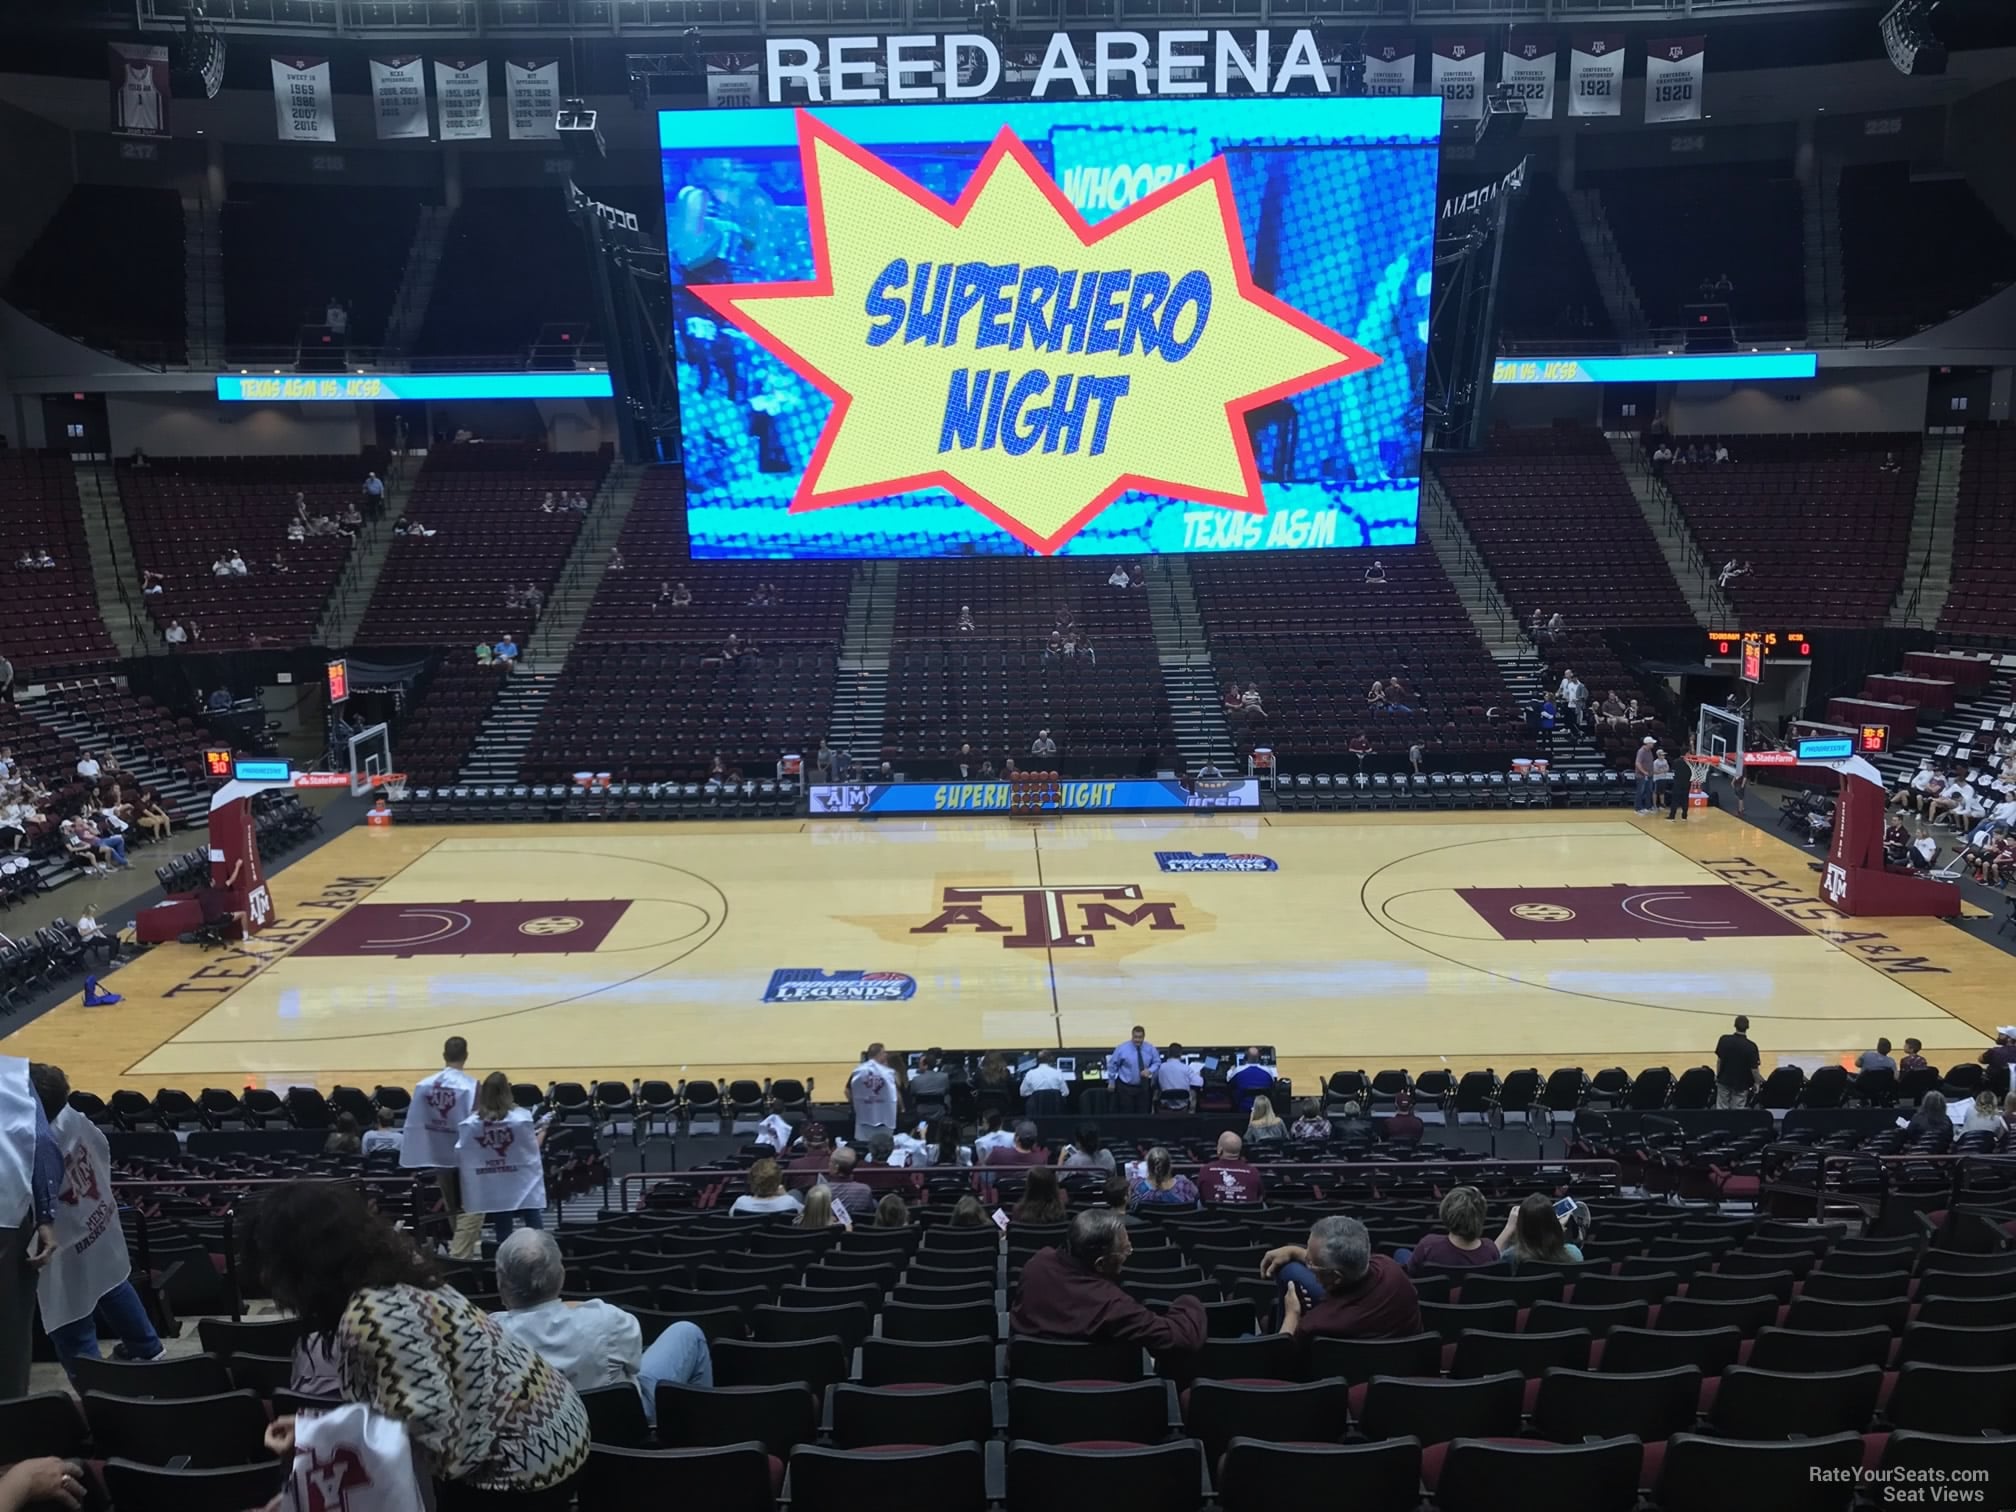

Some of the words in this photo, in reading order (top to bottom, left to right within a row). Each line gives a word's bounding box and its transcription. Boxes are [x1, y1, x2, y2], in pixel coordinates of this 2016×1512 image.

[765, 34, 1001, 102] REED
[1030, 29, 1332, 97] ARENA
[291, 84, 315, 95] 1969
[1440, 84, 1475, 100] 1923
[1580, 80, 1611, 96] 1921
[1655, 85, 1692, 102] 1920
[292, 96, 316, 107] 1980
[292, 108, 317, 119] 2007
[294, 120, 318, 131] 2016
[865, 258, 1213, 363] SUPERHERO
[1544, 361, 1578, 380] UCSB
[240, 379, 280, 398] TEXAS
[346, 378, 382, 398] UCSB
[938, 367, 1131, 457] NIGHT
[1182, 508, 1264, 550] TEXAS
[1266, 506, 1339, 548] A&M
[1720, 642, 1728, 653] 0
[1801, 643, 1810, 655] 0
[1865, 738, 1881, 749] 30
[212, 762, 227, 774] 30
[1169, 862, 1267, 870] LEGENDS
[297, 875, 387, 910] A&M
[1701, 857, 1851, 920] TEXAS
[1818, 929, 1953, 974] A&M
[778, 980, 911, 988] PROGRESSIVE
[775, 986, 902, 998] LEGENDS
